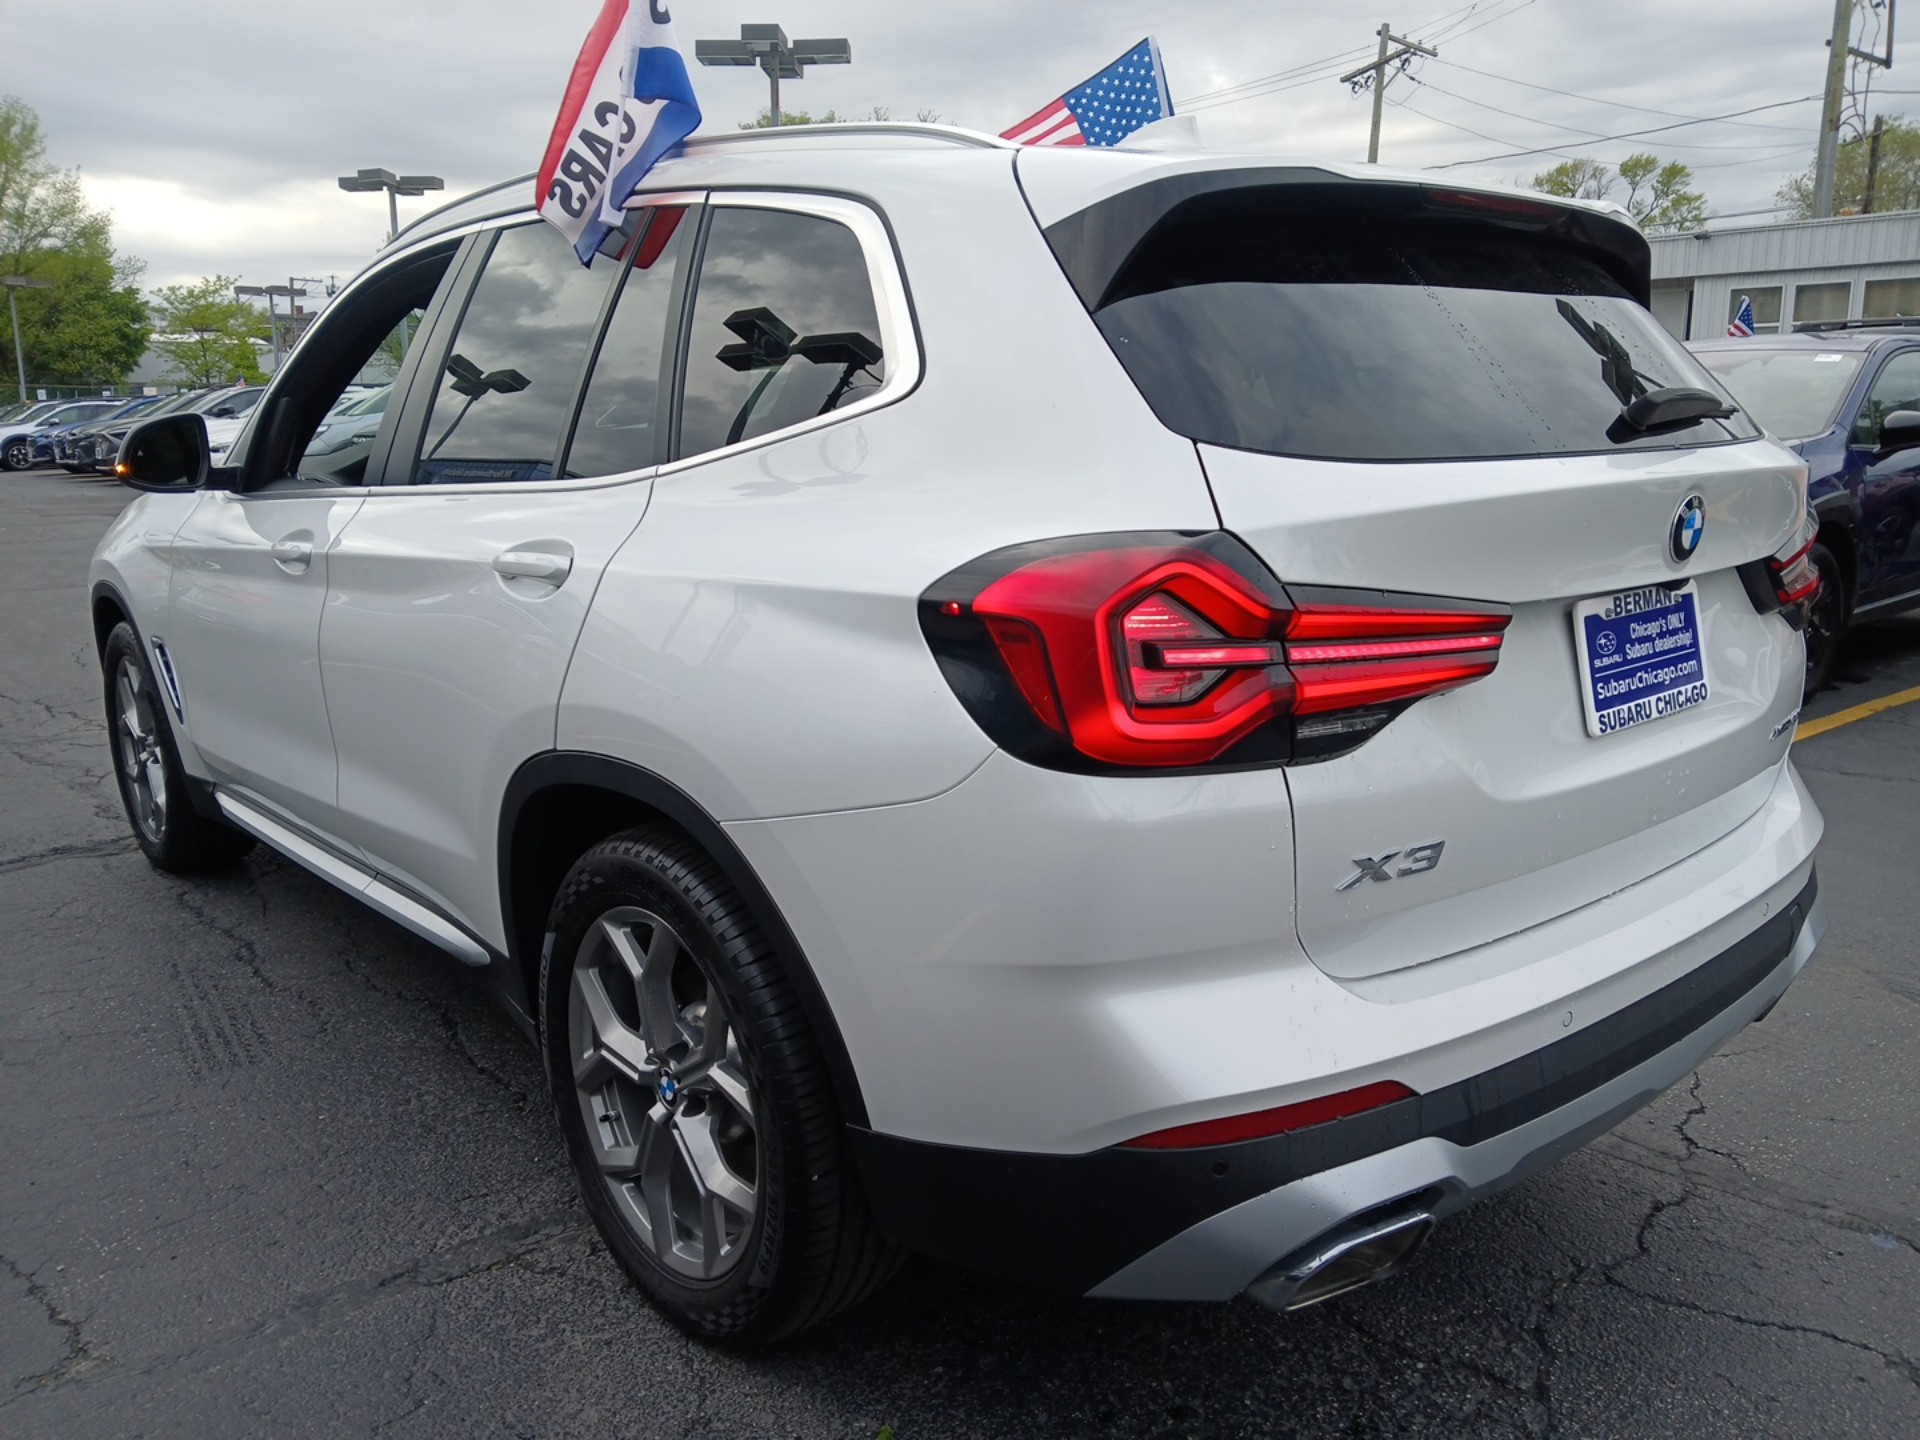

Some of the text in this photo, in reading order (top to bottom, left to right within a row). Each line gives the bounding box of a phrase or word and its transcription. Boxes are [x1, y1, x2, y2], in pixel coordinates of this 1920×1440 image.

[1613, 587, 1673, 617] BERMAN
[1630, 611, 1685, 639] Chicago's ONLY
[1594, 653, 1623, 668] SUBARU
[1625, 642, 1653, 660] Subaru
[1596, 659, 1698, 699] SubaruChicago.com
[1598, 683, 1708, 734] SUBARU CHICAGO
[1335, 839, 1446, 892] X3
